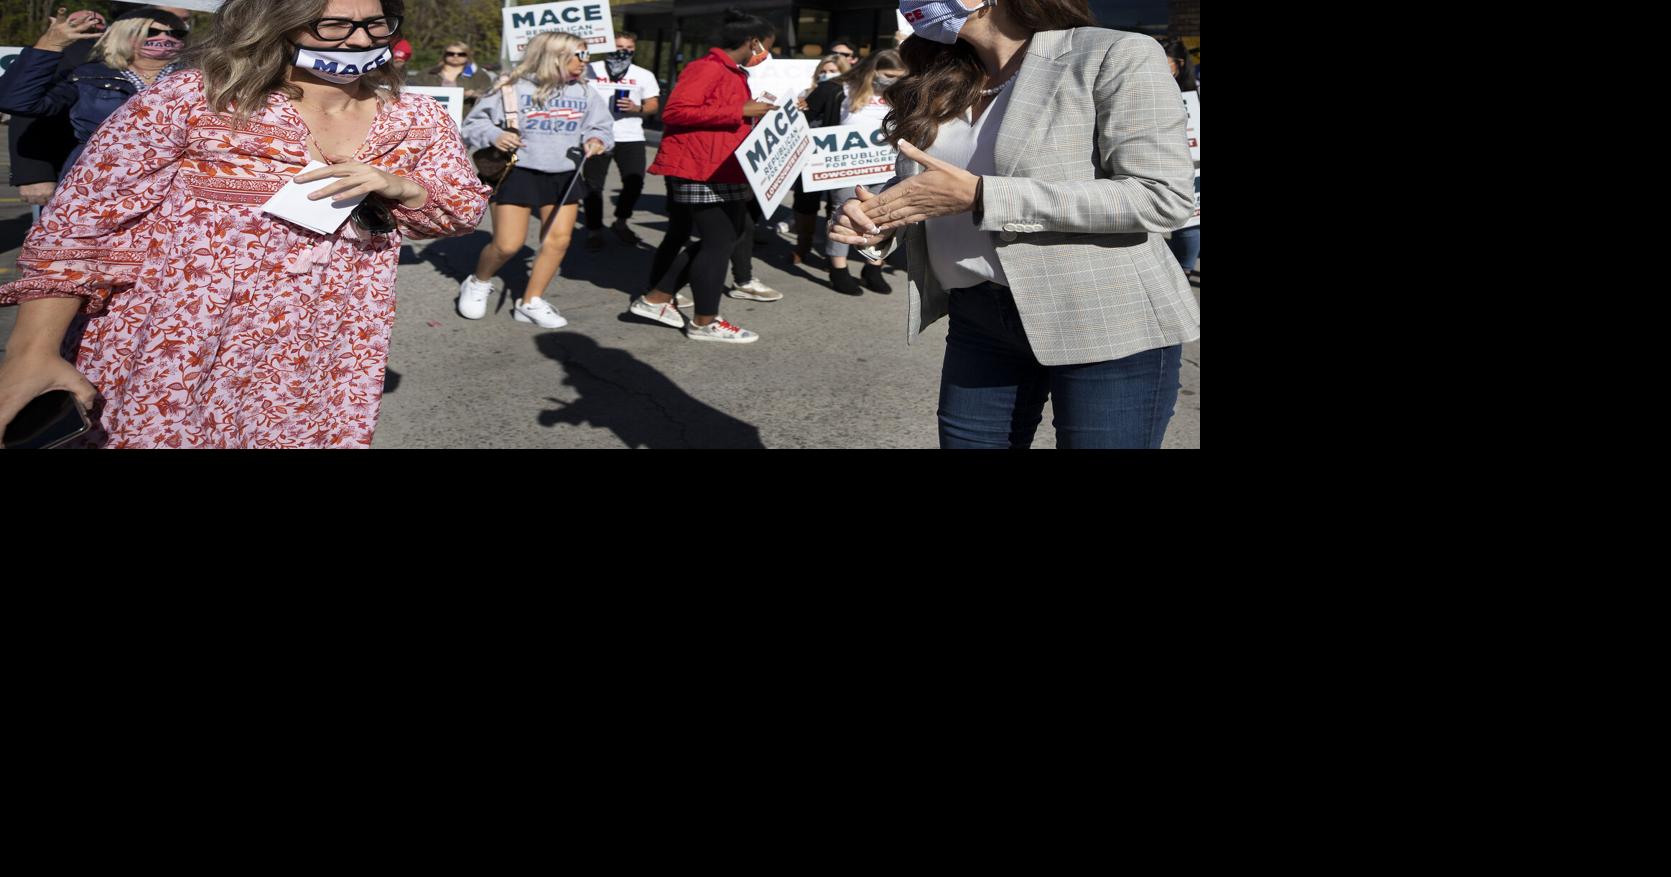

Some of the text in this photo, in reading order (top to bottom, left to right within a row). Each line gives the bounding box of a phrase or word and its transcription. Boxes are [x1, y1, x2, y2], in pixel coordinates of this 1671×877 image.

[511, 4, 603, 29] MACE
[312, 54, 386, 75] MACE
[520, 94, 588, 112] Tump
[526, 118, 578, 132] 2020
[745, 98, 799, 173] MACE
[763, 128, 798, 176] REPUBLICAN
[812, 128, 890, 155] MAC
[825, 149, 898, 163] REPUBLICA
[850, 155, 897, 166] CONGRE
[765, 150, 799, 201] LOWCOUNTRY
[814, 166, 887, 180] LOWCOUNTRY
